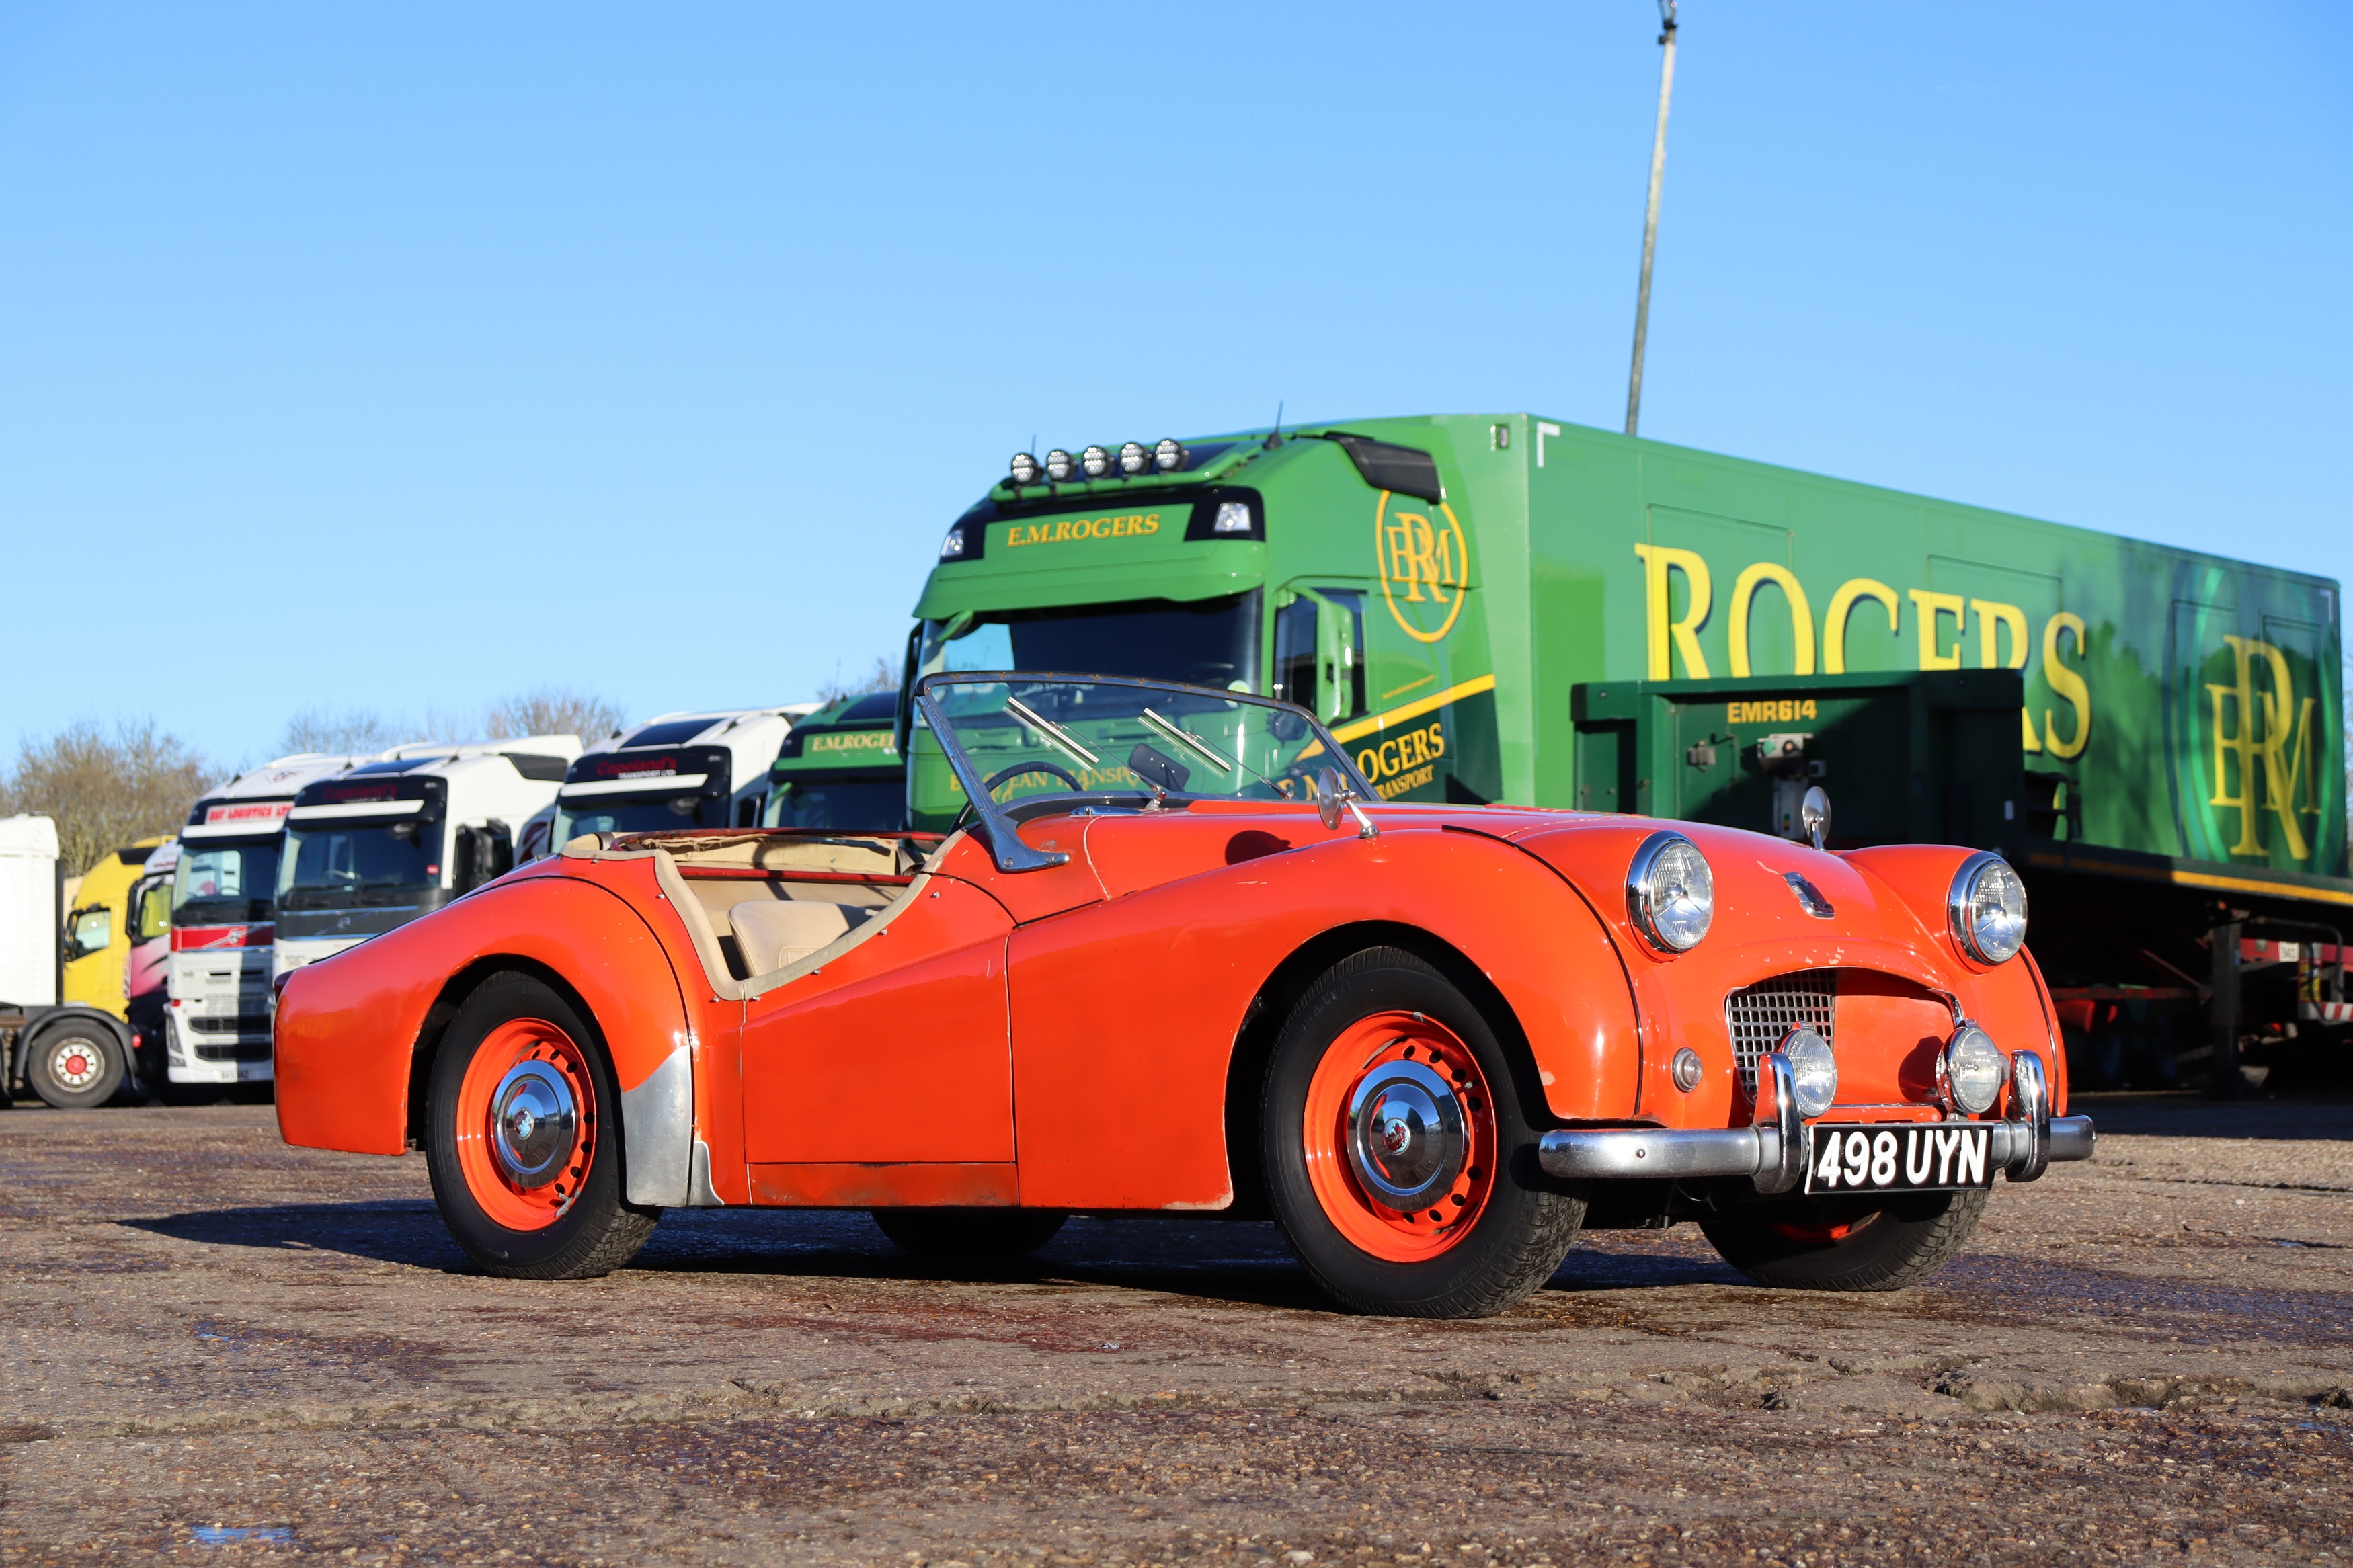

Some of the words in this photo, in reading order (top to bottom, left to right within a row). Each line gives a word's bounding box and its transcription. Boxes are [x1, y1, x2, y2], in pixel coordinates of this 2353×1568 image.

[1007, 513, 1160, 548] E.M.ROGERS
[1727, 699, 1817, 724] EMR614
[1350, 722, 1445, 784] OGERS
[1375, 764, 1434, 800] RANSPORT
[1817, 1130, 1898, 1187] 498
[1906, 1130, 1987, 1184] UYN
